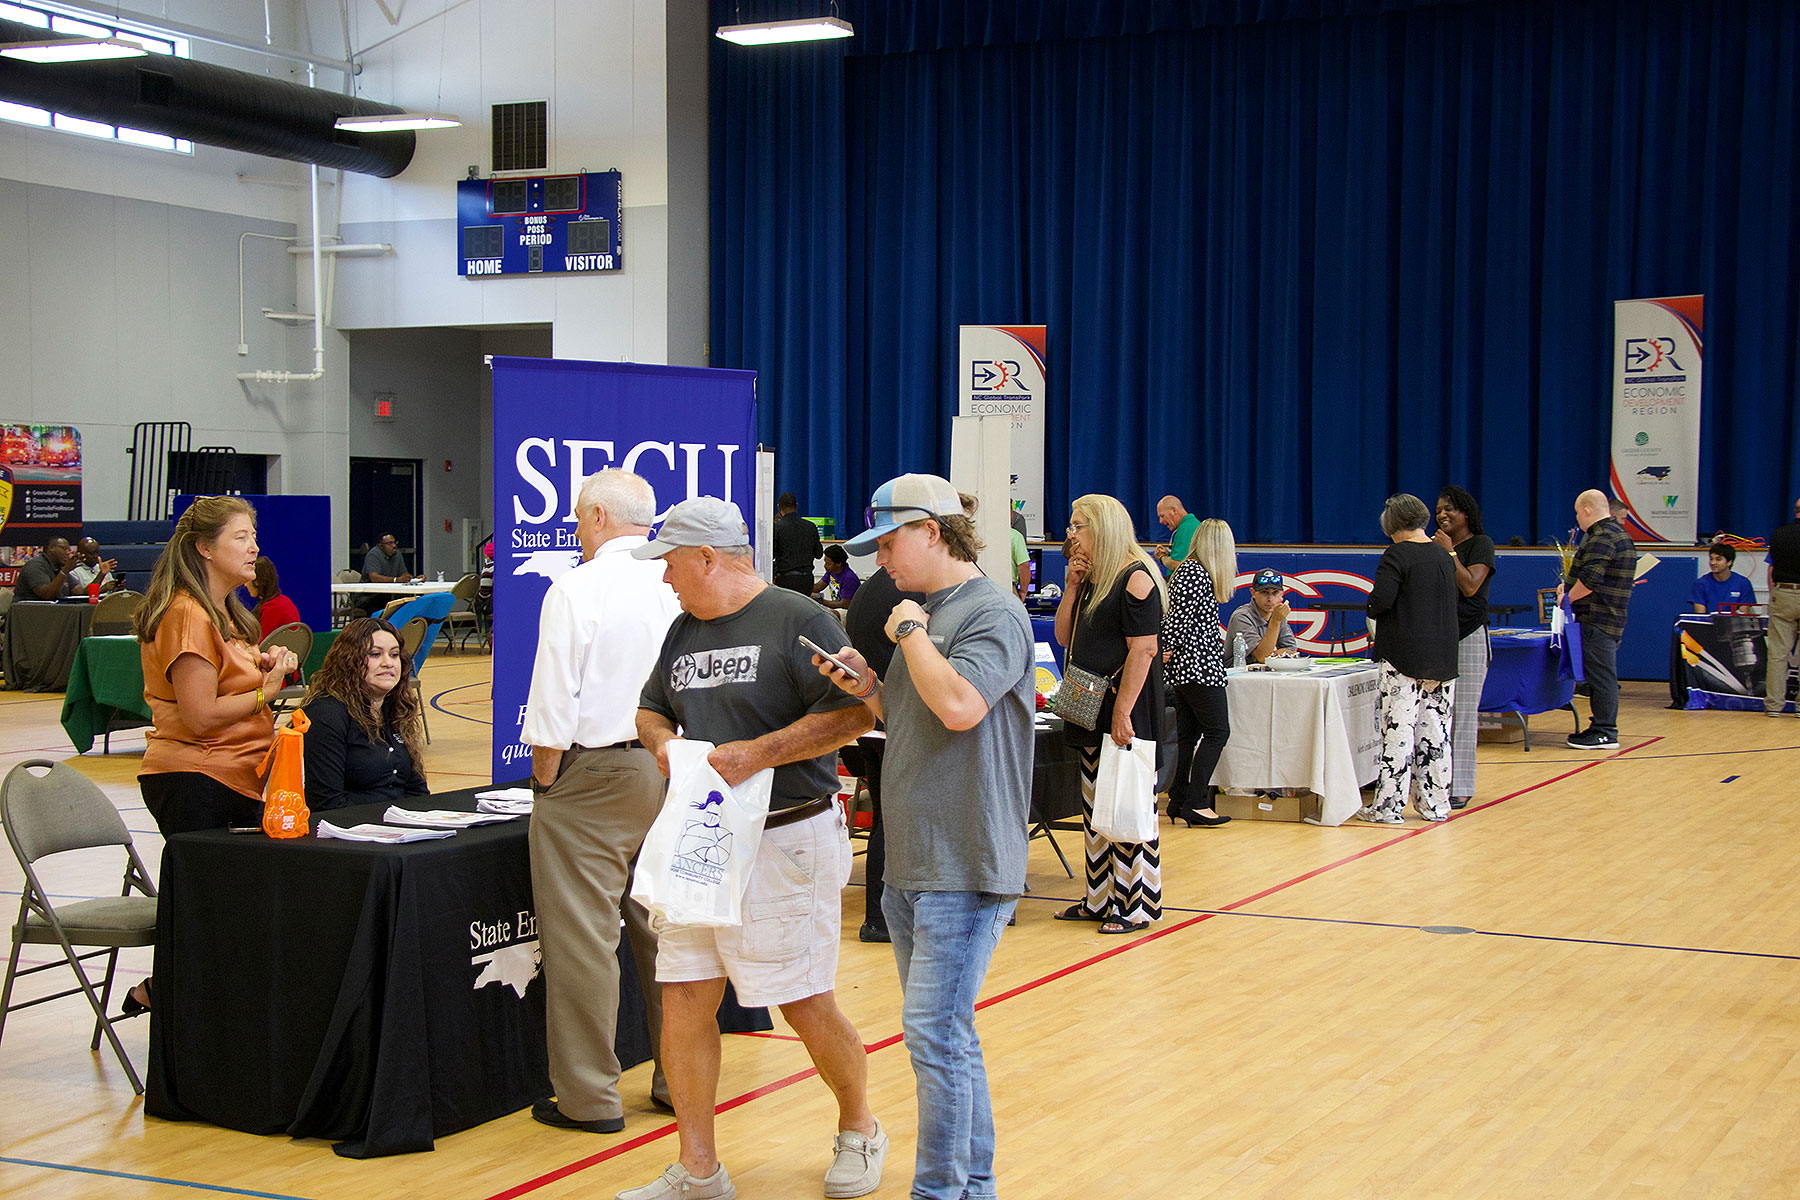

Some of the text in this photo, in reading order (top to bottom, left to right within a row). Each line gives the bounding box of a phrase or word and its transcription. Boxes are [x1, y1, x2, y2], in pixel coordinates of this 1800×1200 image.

[524, 216, 548, 225] BONUS
[527, 226, 545, 234] POSS
[519, 233, 552, 246] PERIOD
[467, 259, 503, 275] HOME
[565, 254, 614, 271] VISITOR
[1624, 386, 1685, 399] ECONOMIC
[971, 404, 1031, 413] ECONOMIC
[1632, 407, 1677, 415] REGION
[511, 528, 551, 549] State
[697, 654, 752, 680] Jeep
[470, 920, 511, 950] State
